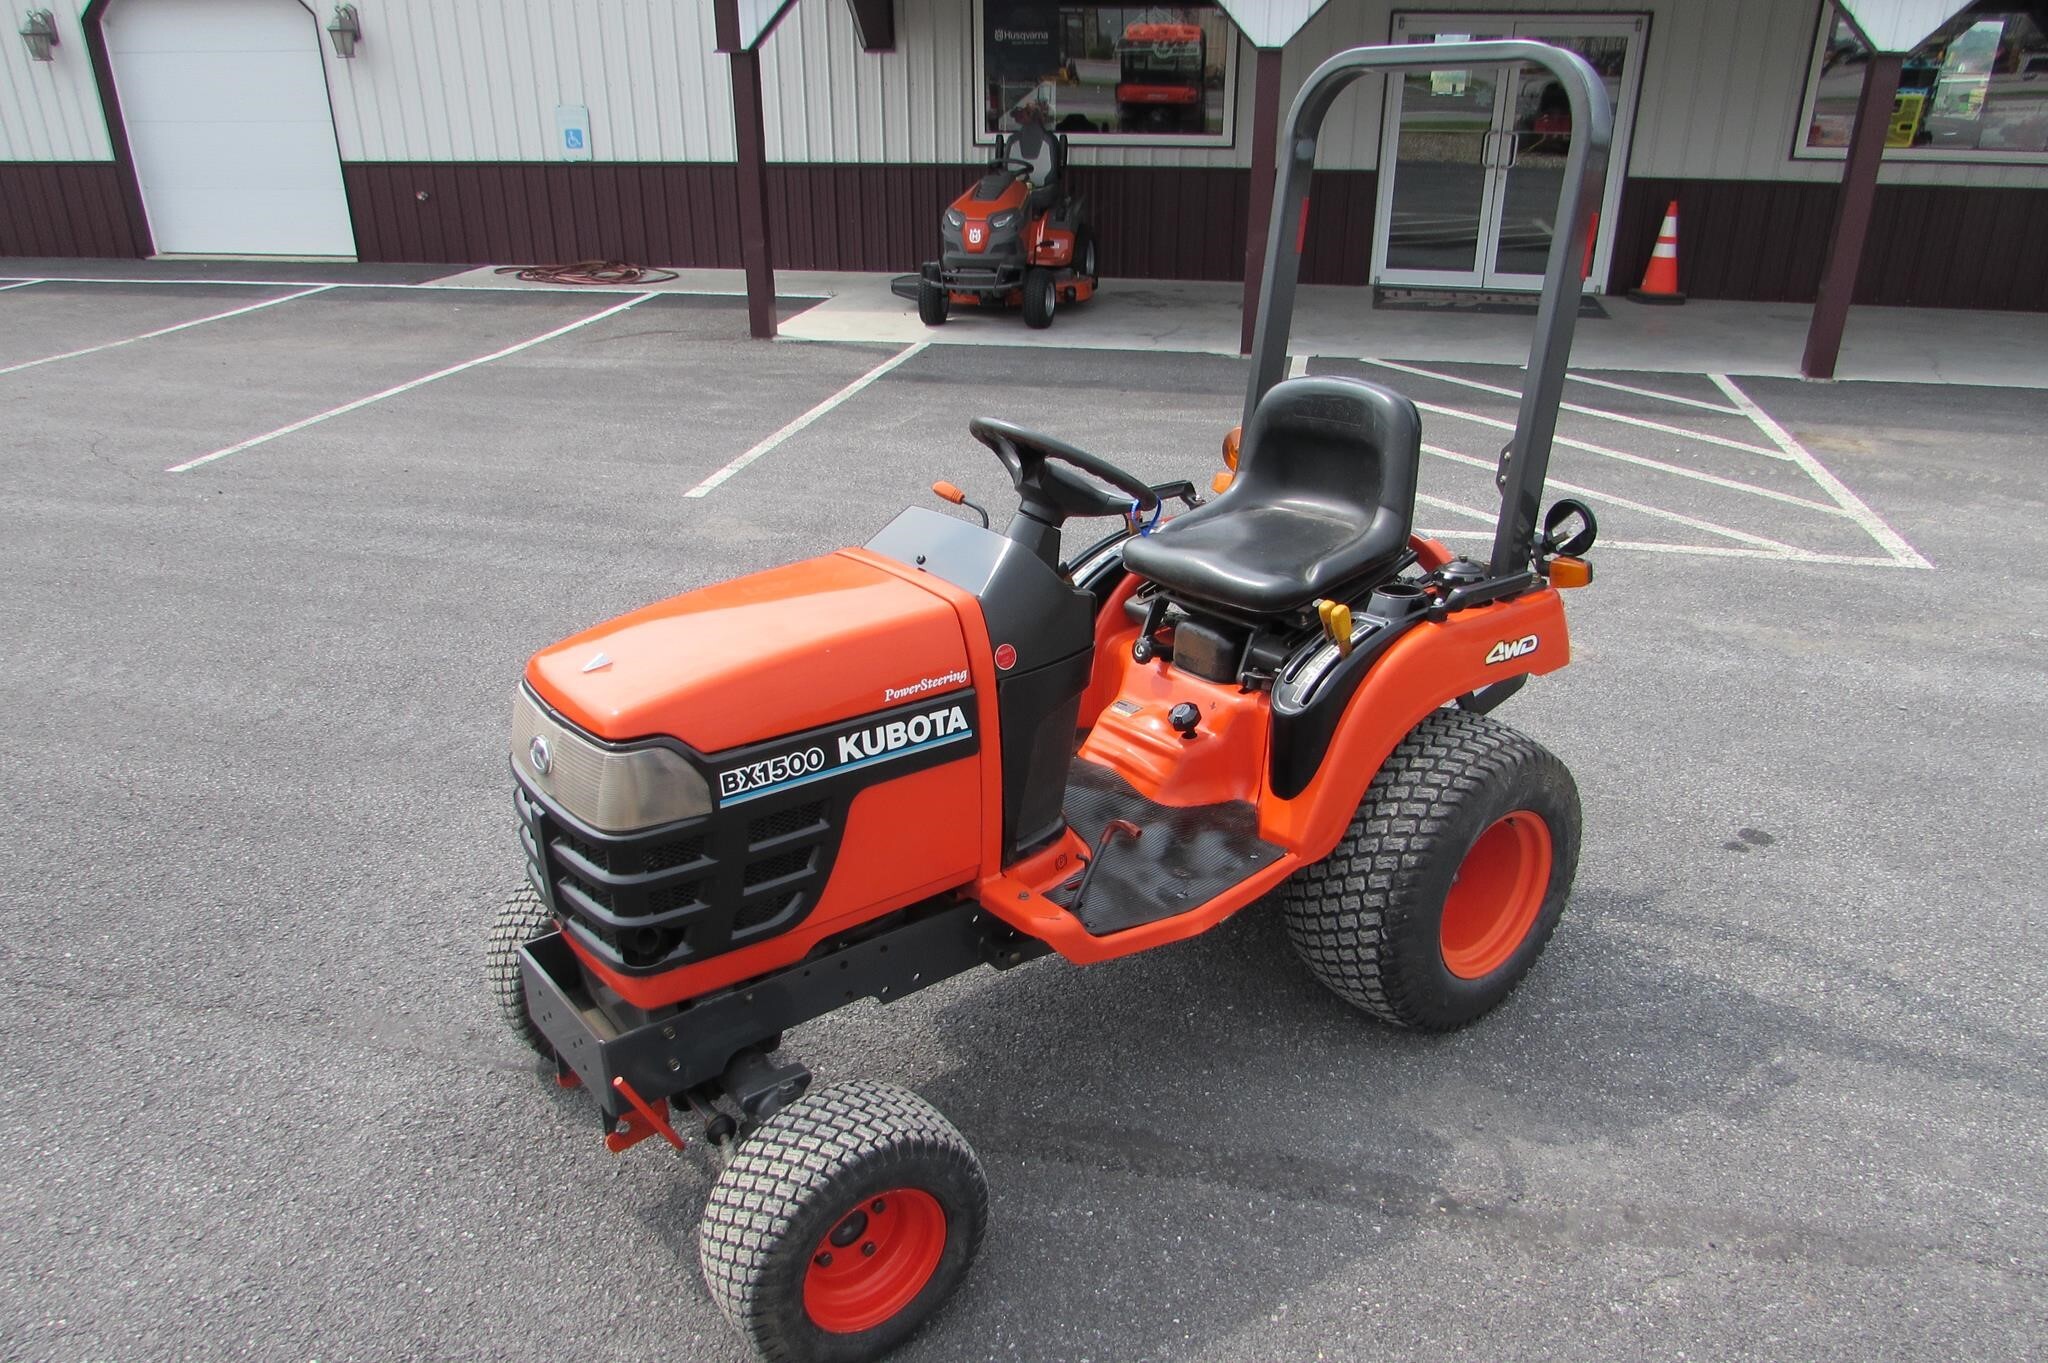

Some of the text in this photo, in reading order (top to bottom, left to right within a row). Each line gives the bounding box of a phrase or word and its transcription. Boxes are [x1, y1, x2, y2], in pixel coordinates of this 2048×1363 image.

[1004, 31, 1048, 41] Husqvarna
[1485, 634, 1538, 664] 4WD
[719, 706, 969, 797] BX1500 KUBOTA
